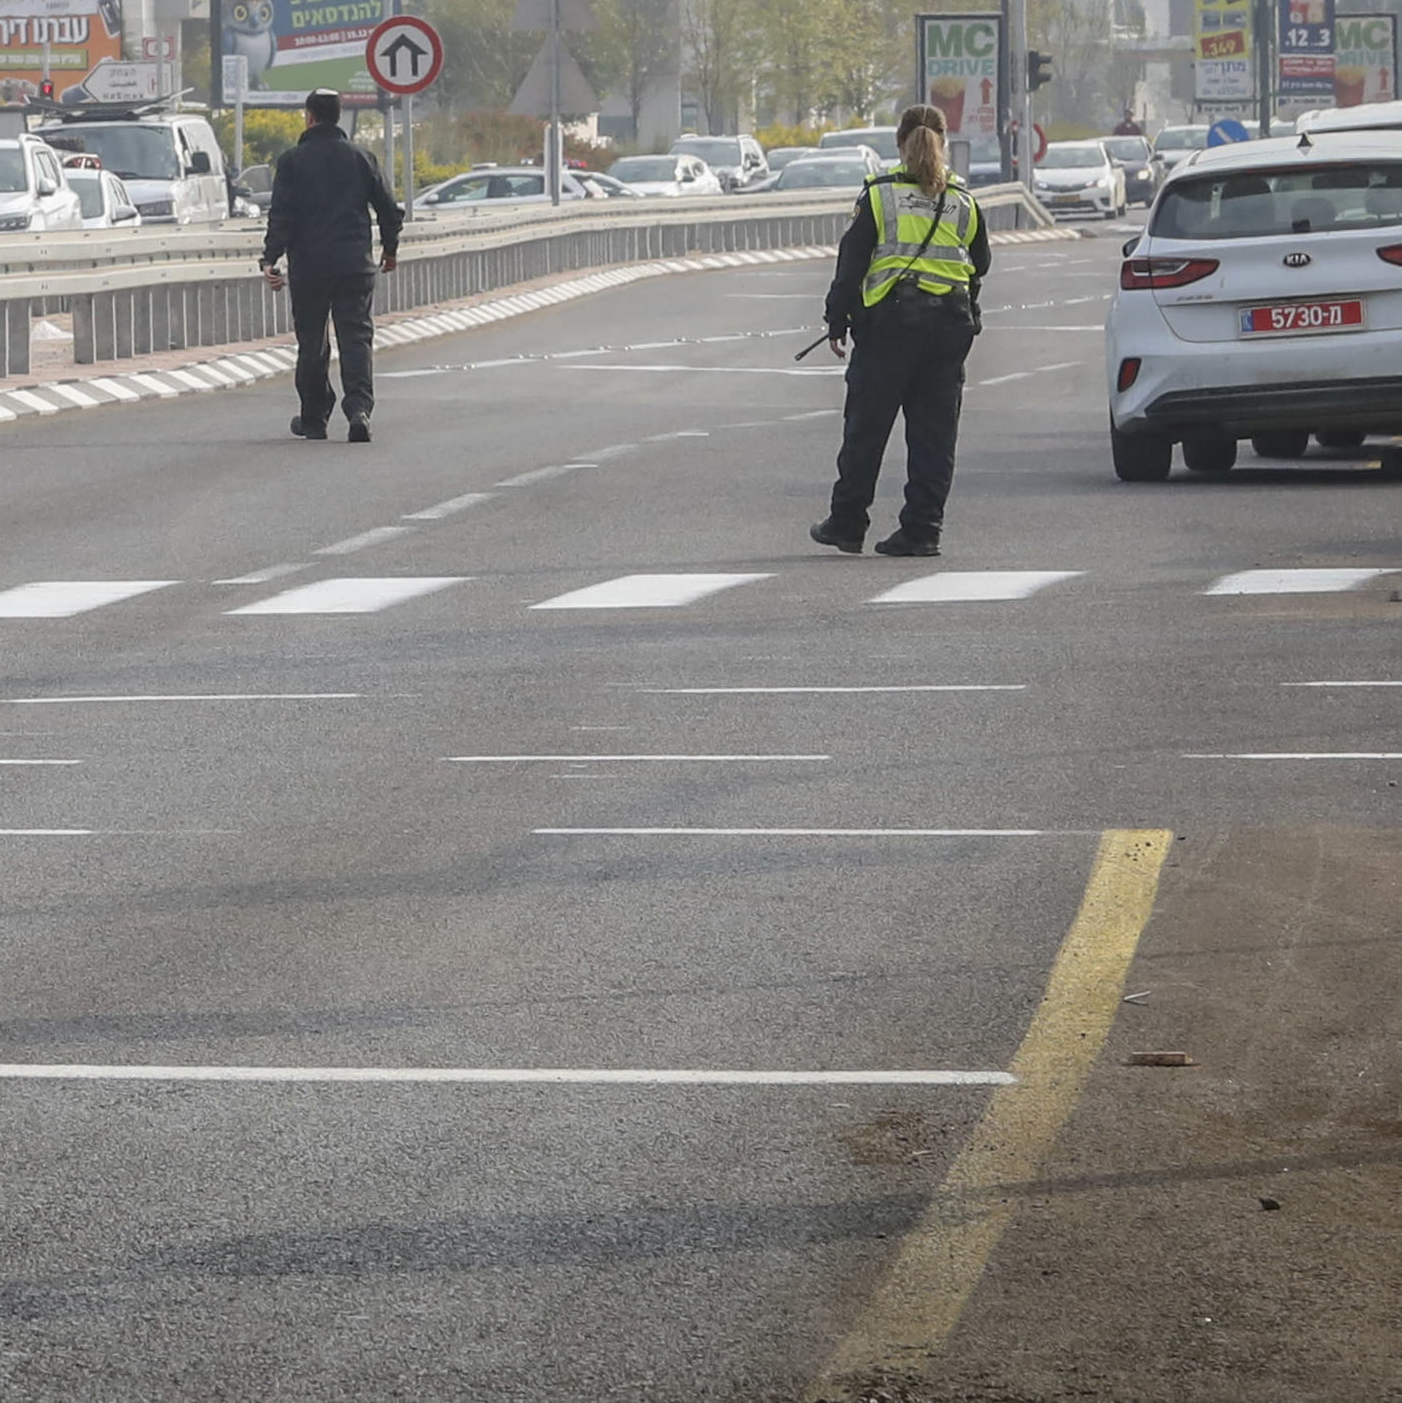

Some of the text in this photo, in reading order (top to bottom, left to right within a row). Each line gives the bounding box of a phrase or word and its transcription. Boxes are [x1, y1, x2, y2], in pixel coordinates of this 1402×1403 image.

[33, 17, 89, 44] עברנו
[927, 23, 995, 58] MC
[1334, 21, 1390, 49] MC
[927, 59, 995, 76] DRIVE
[1286, 253, 1308, 265] KIA
